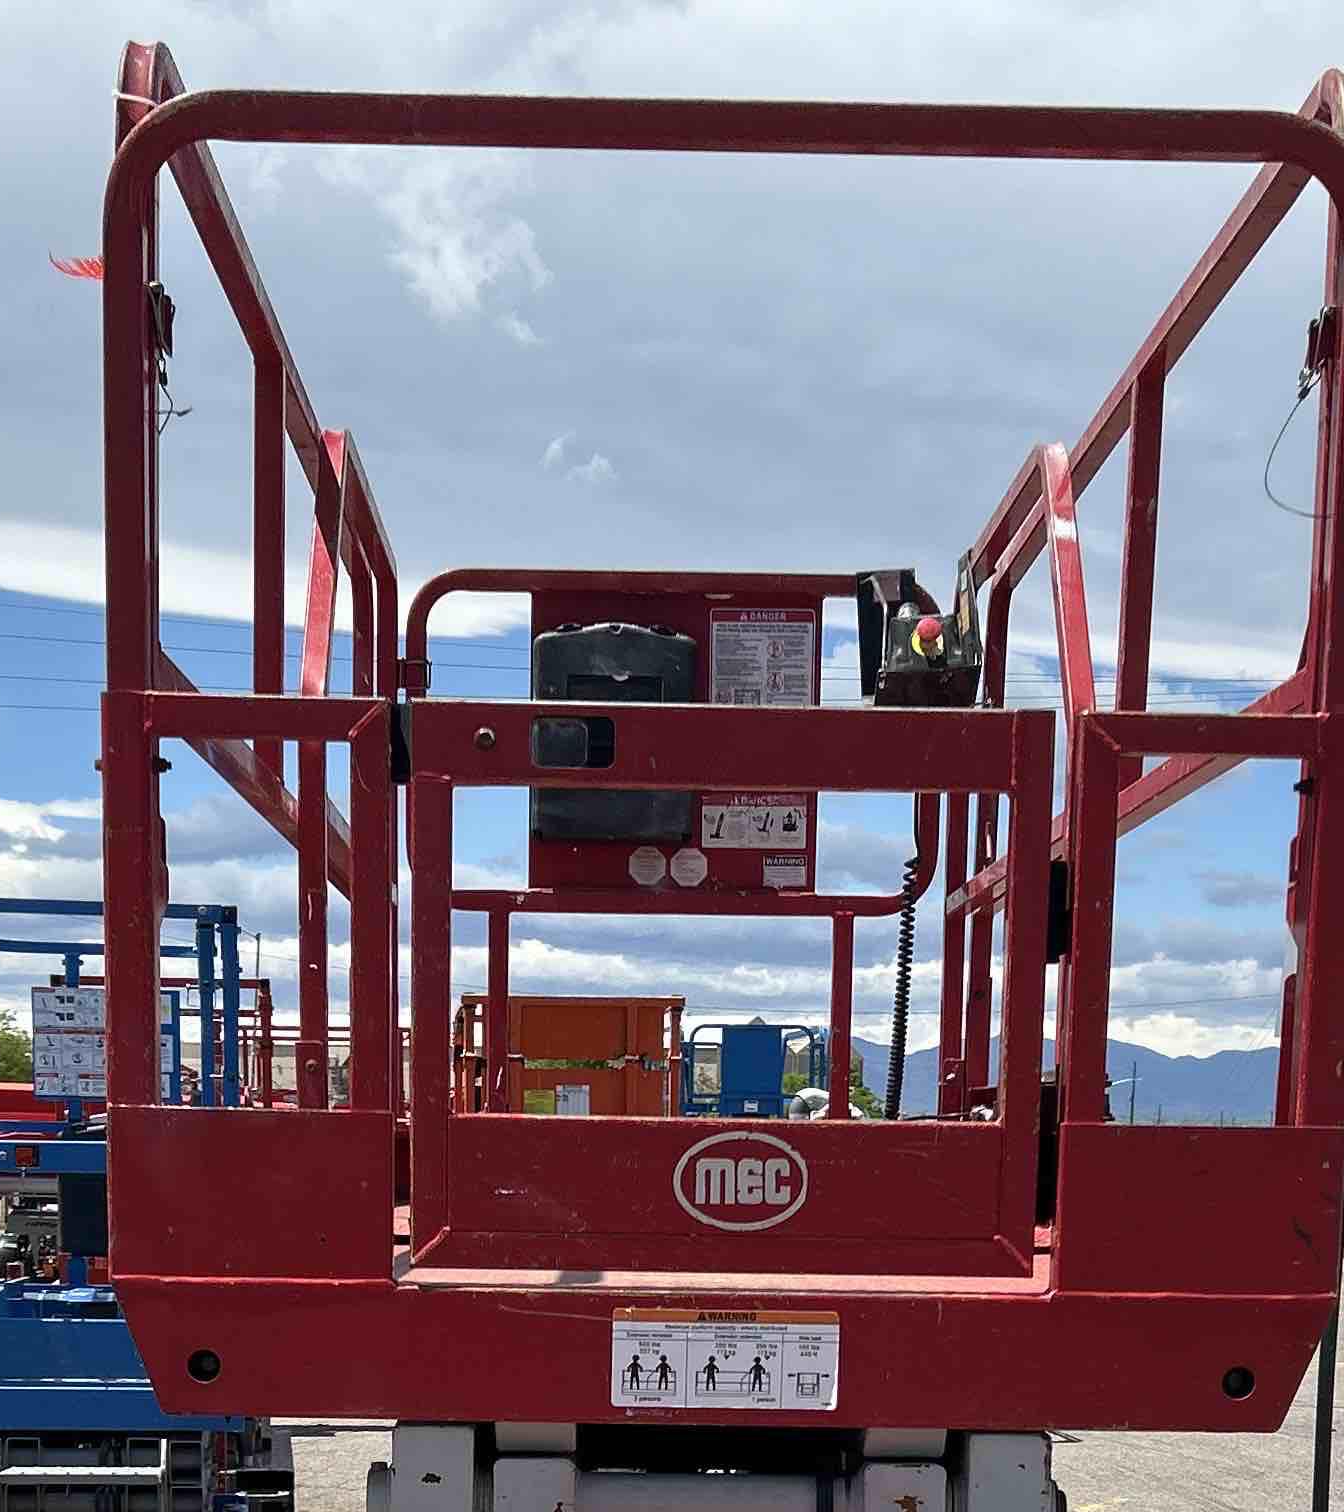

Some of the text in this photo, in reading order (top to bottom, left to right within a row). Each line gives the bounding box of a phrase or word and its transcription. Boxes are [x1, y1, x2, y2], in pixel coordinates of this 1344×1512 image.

[750, 612, 786, 620] DANGER
[767, 856, 805, 866] WARNING
[695, 1157, 791, 1206] MEC
[708, 1312, 757, 1322] WARNING
